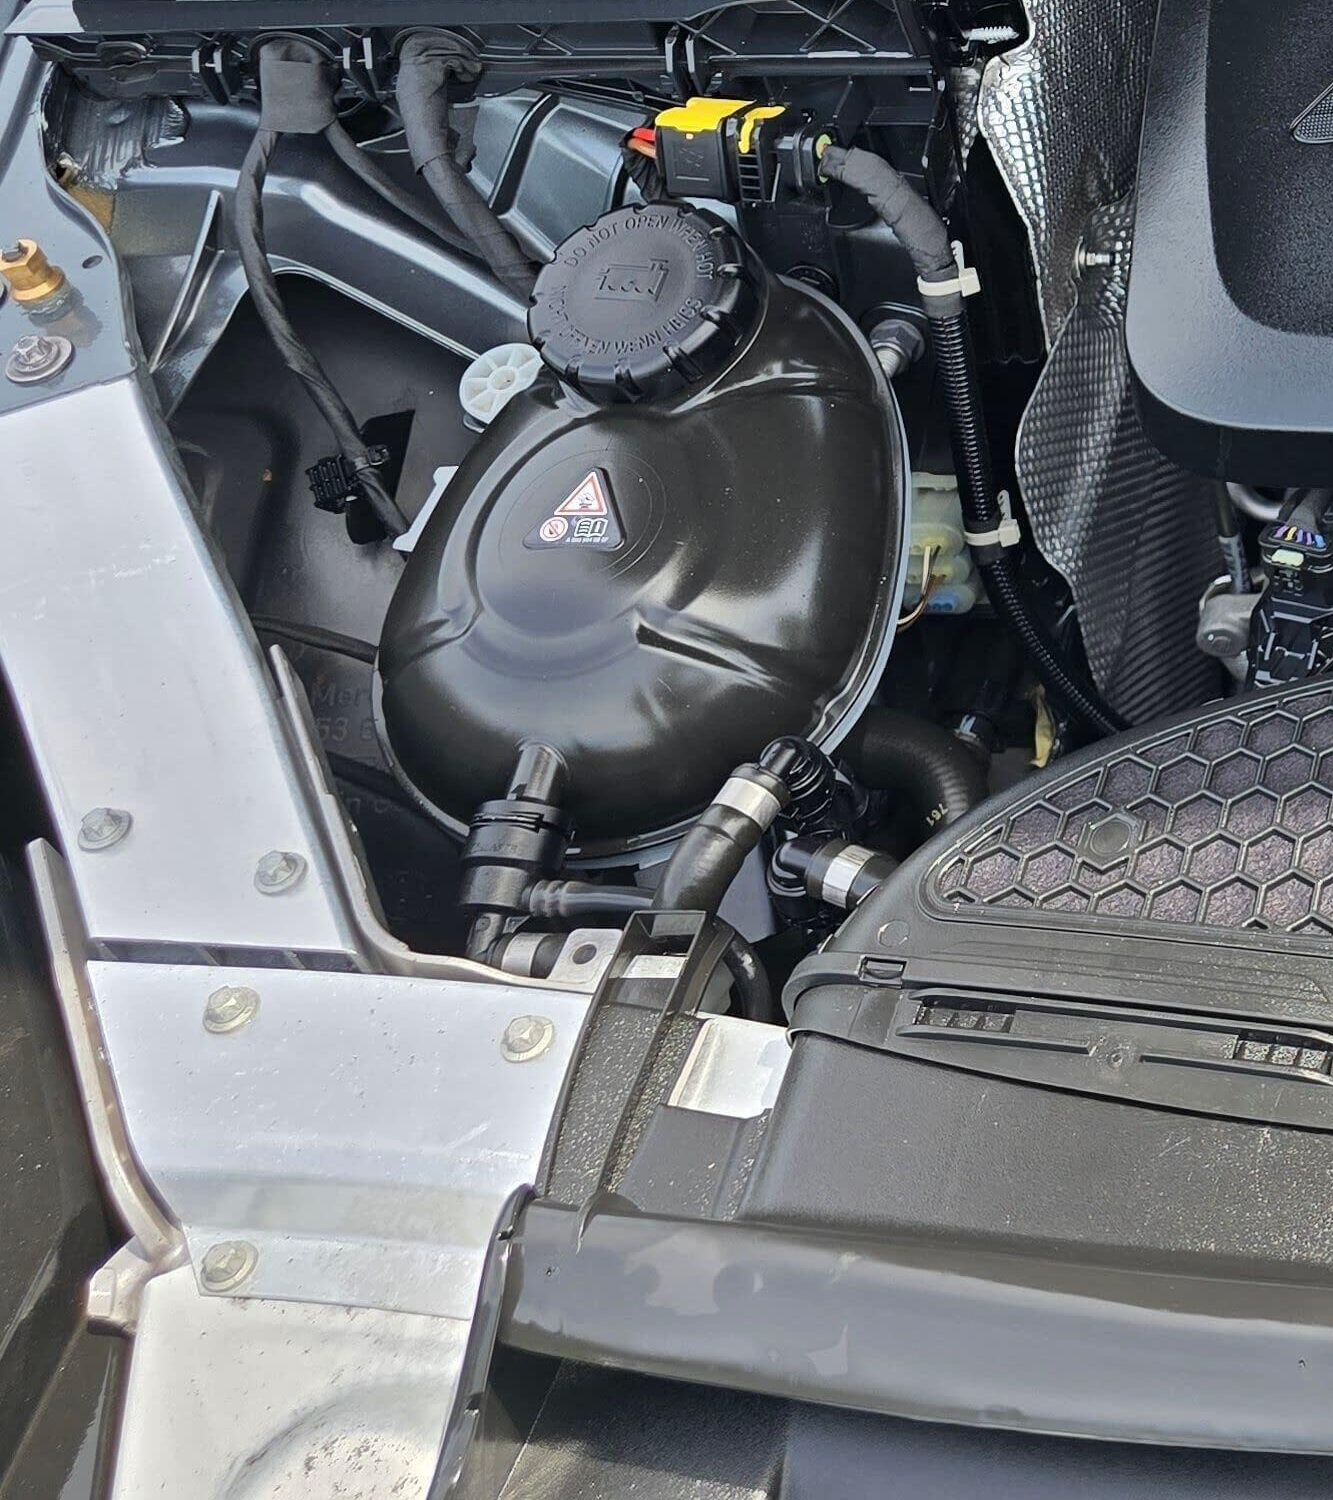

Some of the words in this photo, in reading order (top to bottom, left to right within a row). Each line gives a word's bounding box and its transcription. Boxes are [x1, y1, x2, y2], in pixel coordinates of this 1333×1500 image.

[564, 245, 587, 268] DO
[589, 223, 619, 248] NOT
[623, 214, 670, 231] OPEN
[670, 218, 708, 252] WHEN
[695, 246, 715, 282] HOT
[925, 803, 949, 827] 761
